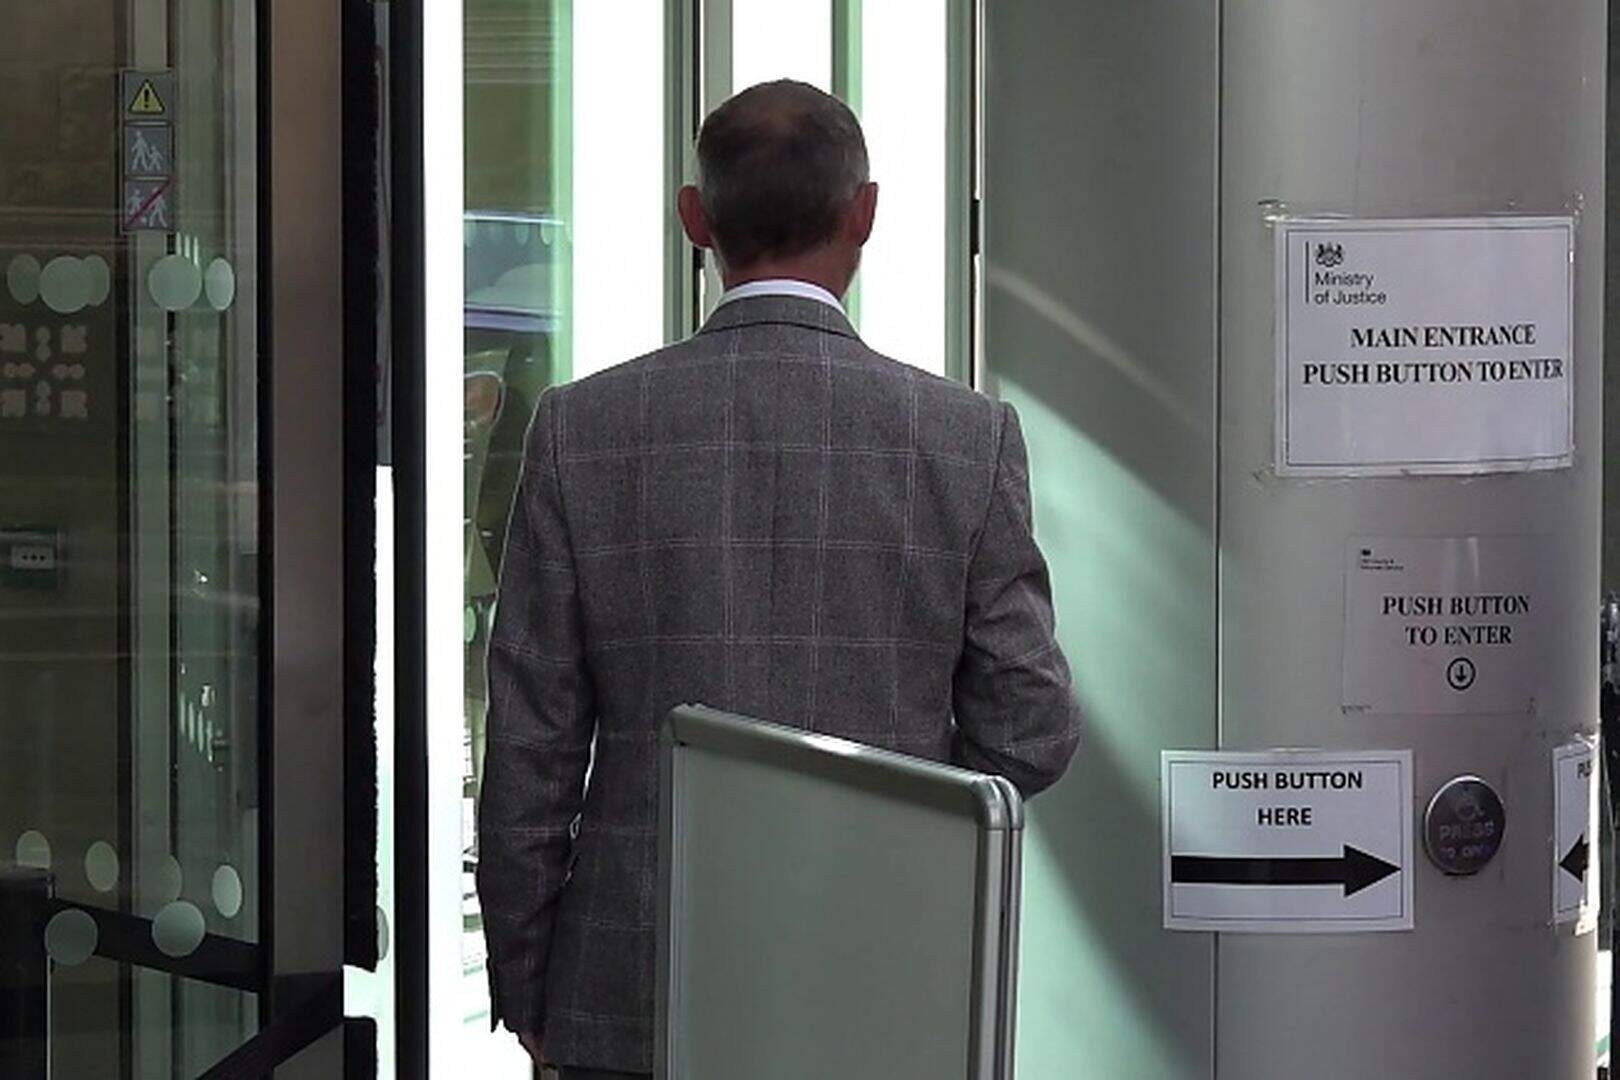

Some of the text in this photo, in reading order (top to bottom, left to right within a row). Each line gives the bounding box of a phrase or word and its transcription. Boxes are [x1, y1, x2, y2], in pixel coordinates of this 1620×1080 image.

[1315, 271, 1374, 290] Ministry
[1315, 290, 1387, 305] of Justice
[1351, 324, 1536, 348] MAIN ENTRANCE
[1303, 359, 1563, 385] PUSH BUTTON TO ENTER
[1382, 595, 1530, 615] PUSH BUTTON
[1405, 625, 1512, 645] TO ENTER
[1212, 772, 1363, 789] PUSH BUTTON
[1257, 808, 1312, 826] HERE
